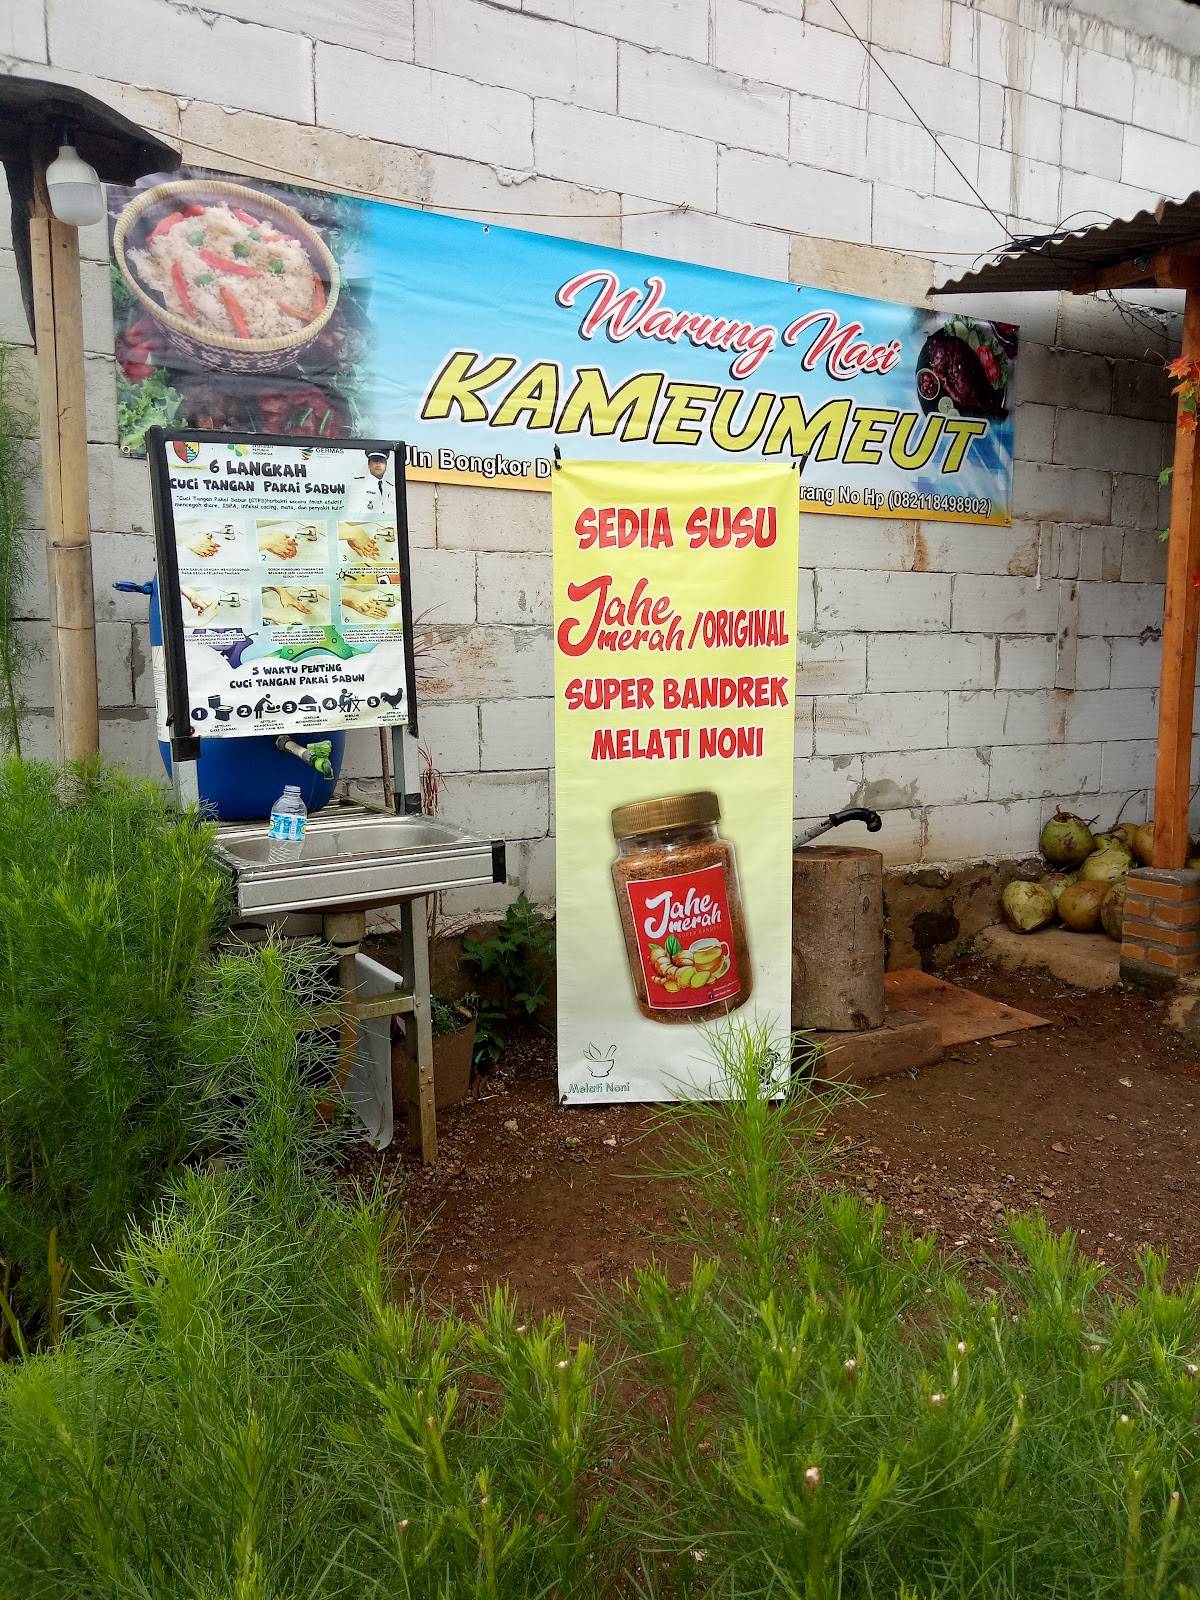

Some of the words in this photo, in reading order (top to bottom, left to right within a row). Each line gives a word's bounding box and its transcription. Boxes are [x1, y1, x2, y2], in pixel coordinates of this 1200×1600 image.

[558, 269, 778, 379] Warung
[784, 310, 902, 380] Nasi
[420, 351, 987, 474] KAMEUMEUT
[209, 459, 220, 474] 6
[226, 461, 307, 478] LANGKAH
[438, 448, 531, 478] Bongkor
[536, 458, 552, 478] D
[203, 480, 255, 492] TANGAN
[305, 481, 345, 494] SABUN
[800, 486, 835, 506] rang
[839, 486, 860, 505] No
[864, 488, 884, 510] Hp
[888, 490, 992, 517] (082118498902)
[575, 506, 674, 550] SEDIA
[686, 506, 777, 549] SUSU
[557, 575, 675, 657] Jahe
[597, 615, 685, 652] merah
[252, 667, 260, 676] 5
[263, 665, 298, 676] WAKTU
[256, 677, 297, 688] TANGAN
[332, 673, 365, 684] SABUN
[564, 677, 656, 711] SUPER
[663, 676, 789, 710] BANDREK
[591, 728, 691, 760] MELATI
[699, 727, 764, 759] NONI
[644, 887, 714, 939] Jahe
[668, 903, 722, 933] merah
[568, 1081, 603, 1094] Melati
[606, 1081, 631, 1093] Noni
